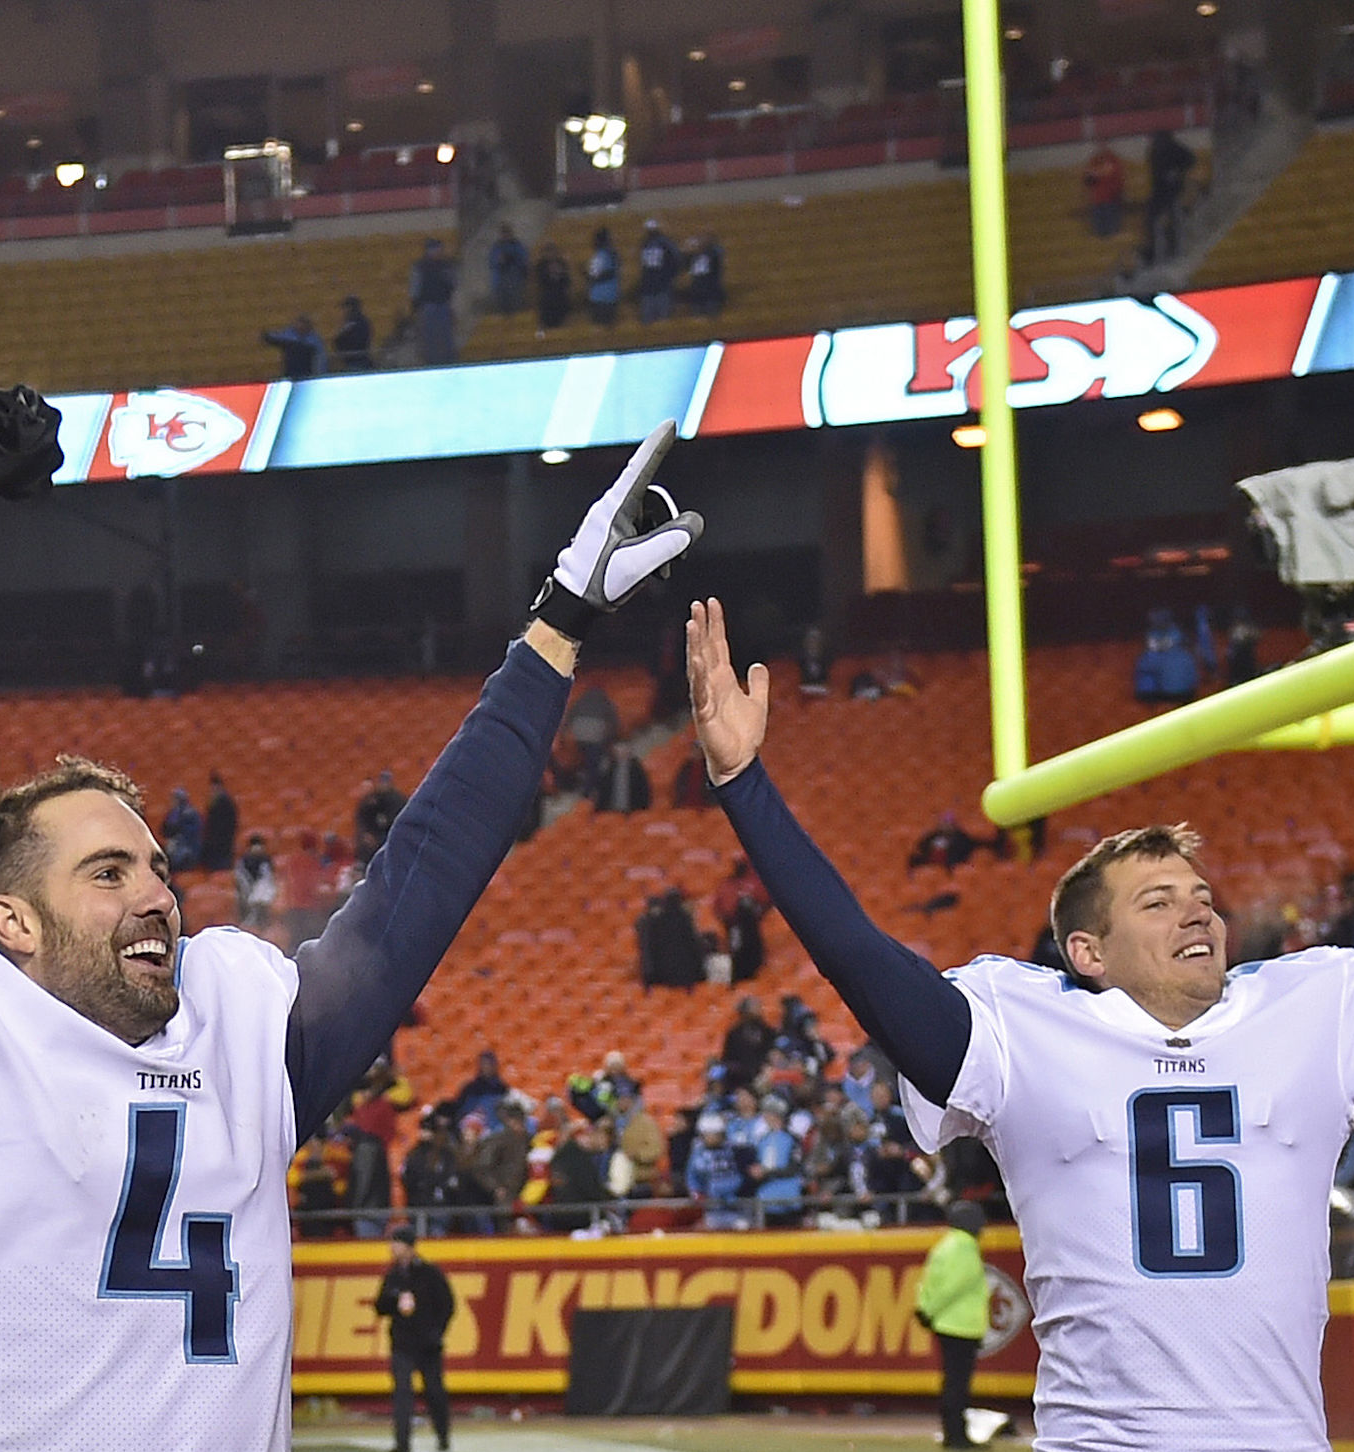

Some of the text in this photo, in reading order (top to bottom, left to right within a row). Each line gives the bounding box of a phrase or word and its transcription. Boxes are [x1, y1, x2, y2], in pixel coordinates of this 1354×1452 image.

[136, 1069, 201, 1090] TITANS
[1153, 1058, 1206, 1074] TITANS
[97, 1101, 241, 1366] 4
[1126, 1084, 1246, 1280] 6
